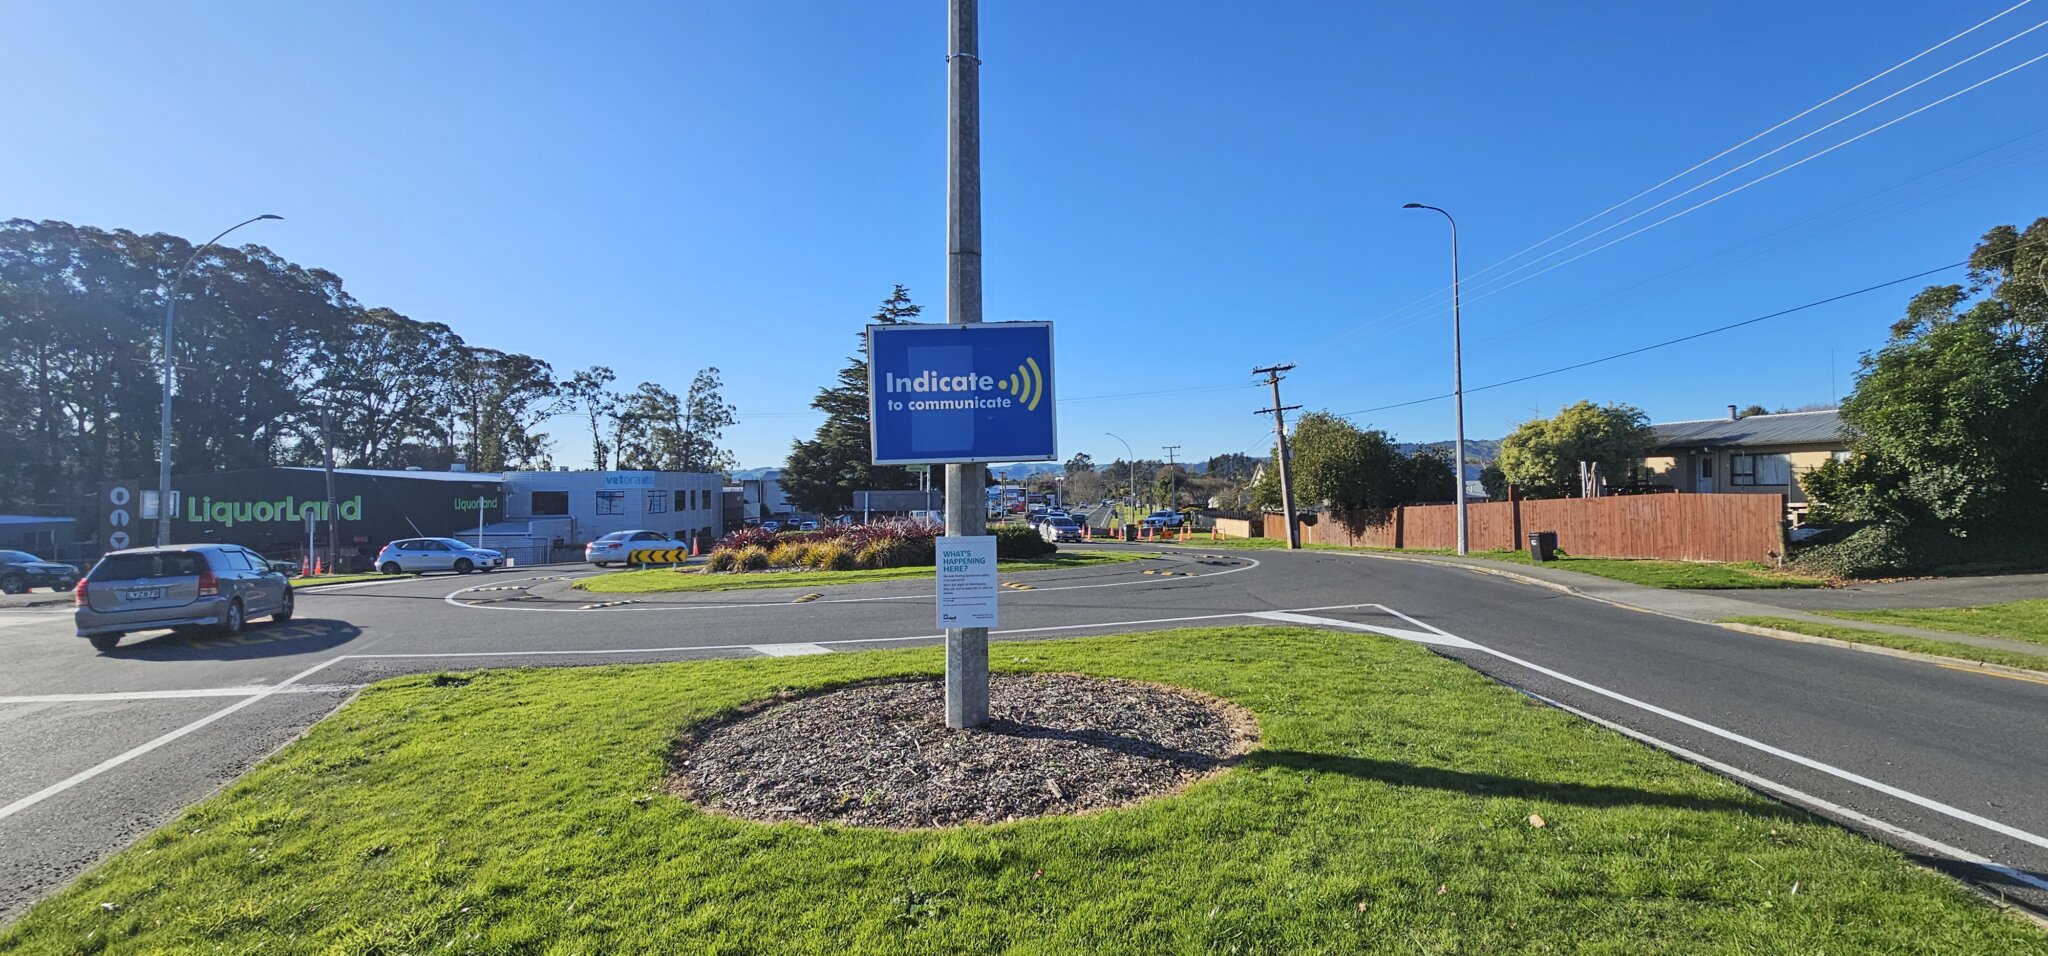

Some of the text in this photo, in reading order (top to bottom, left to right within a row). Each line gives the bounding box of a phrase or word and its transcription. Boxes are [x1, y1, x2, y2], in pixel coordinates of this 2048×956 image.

[886, 370, 994, 393] Indicate
[887, 396, 1012, 411] to communicate
[188, 495, 362, 527] LiquorLand
[454, 497, 498, 511] Liquorand
[943, 557, 986, 565] HAPPENING
